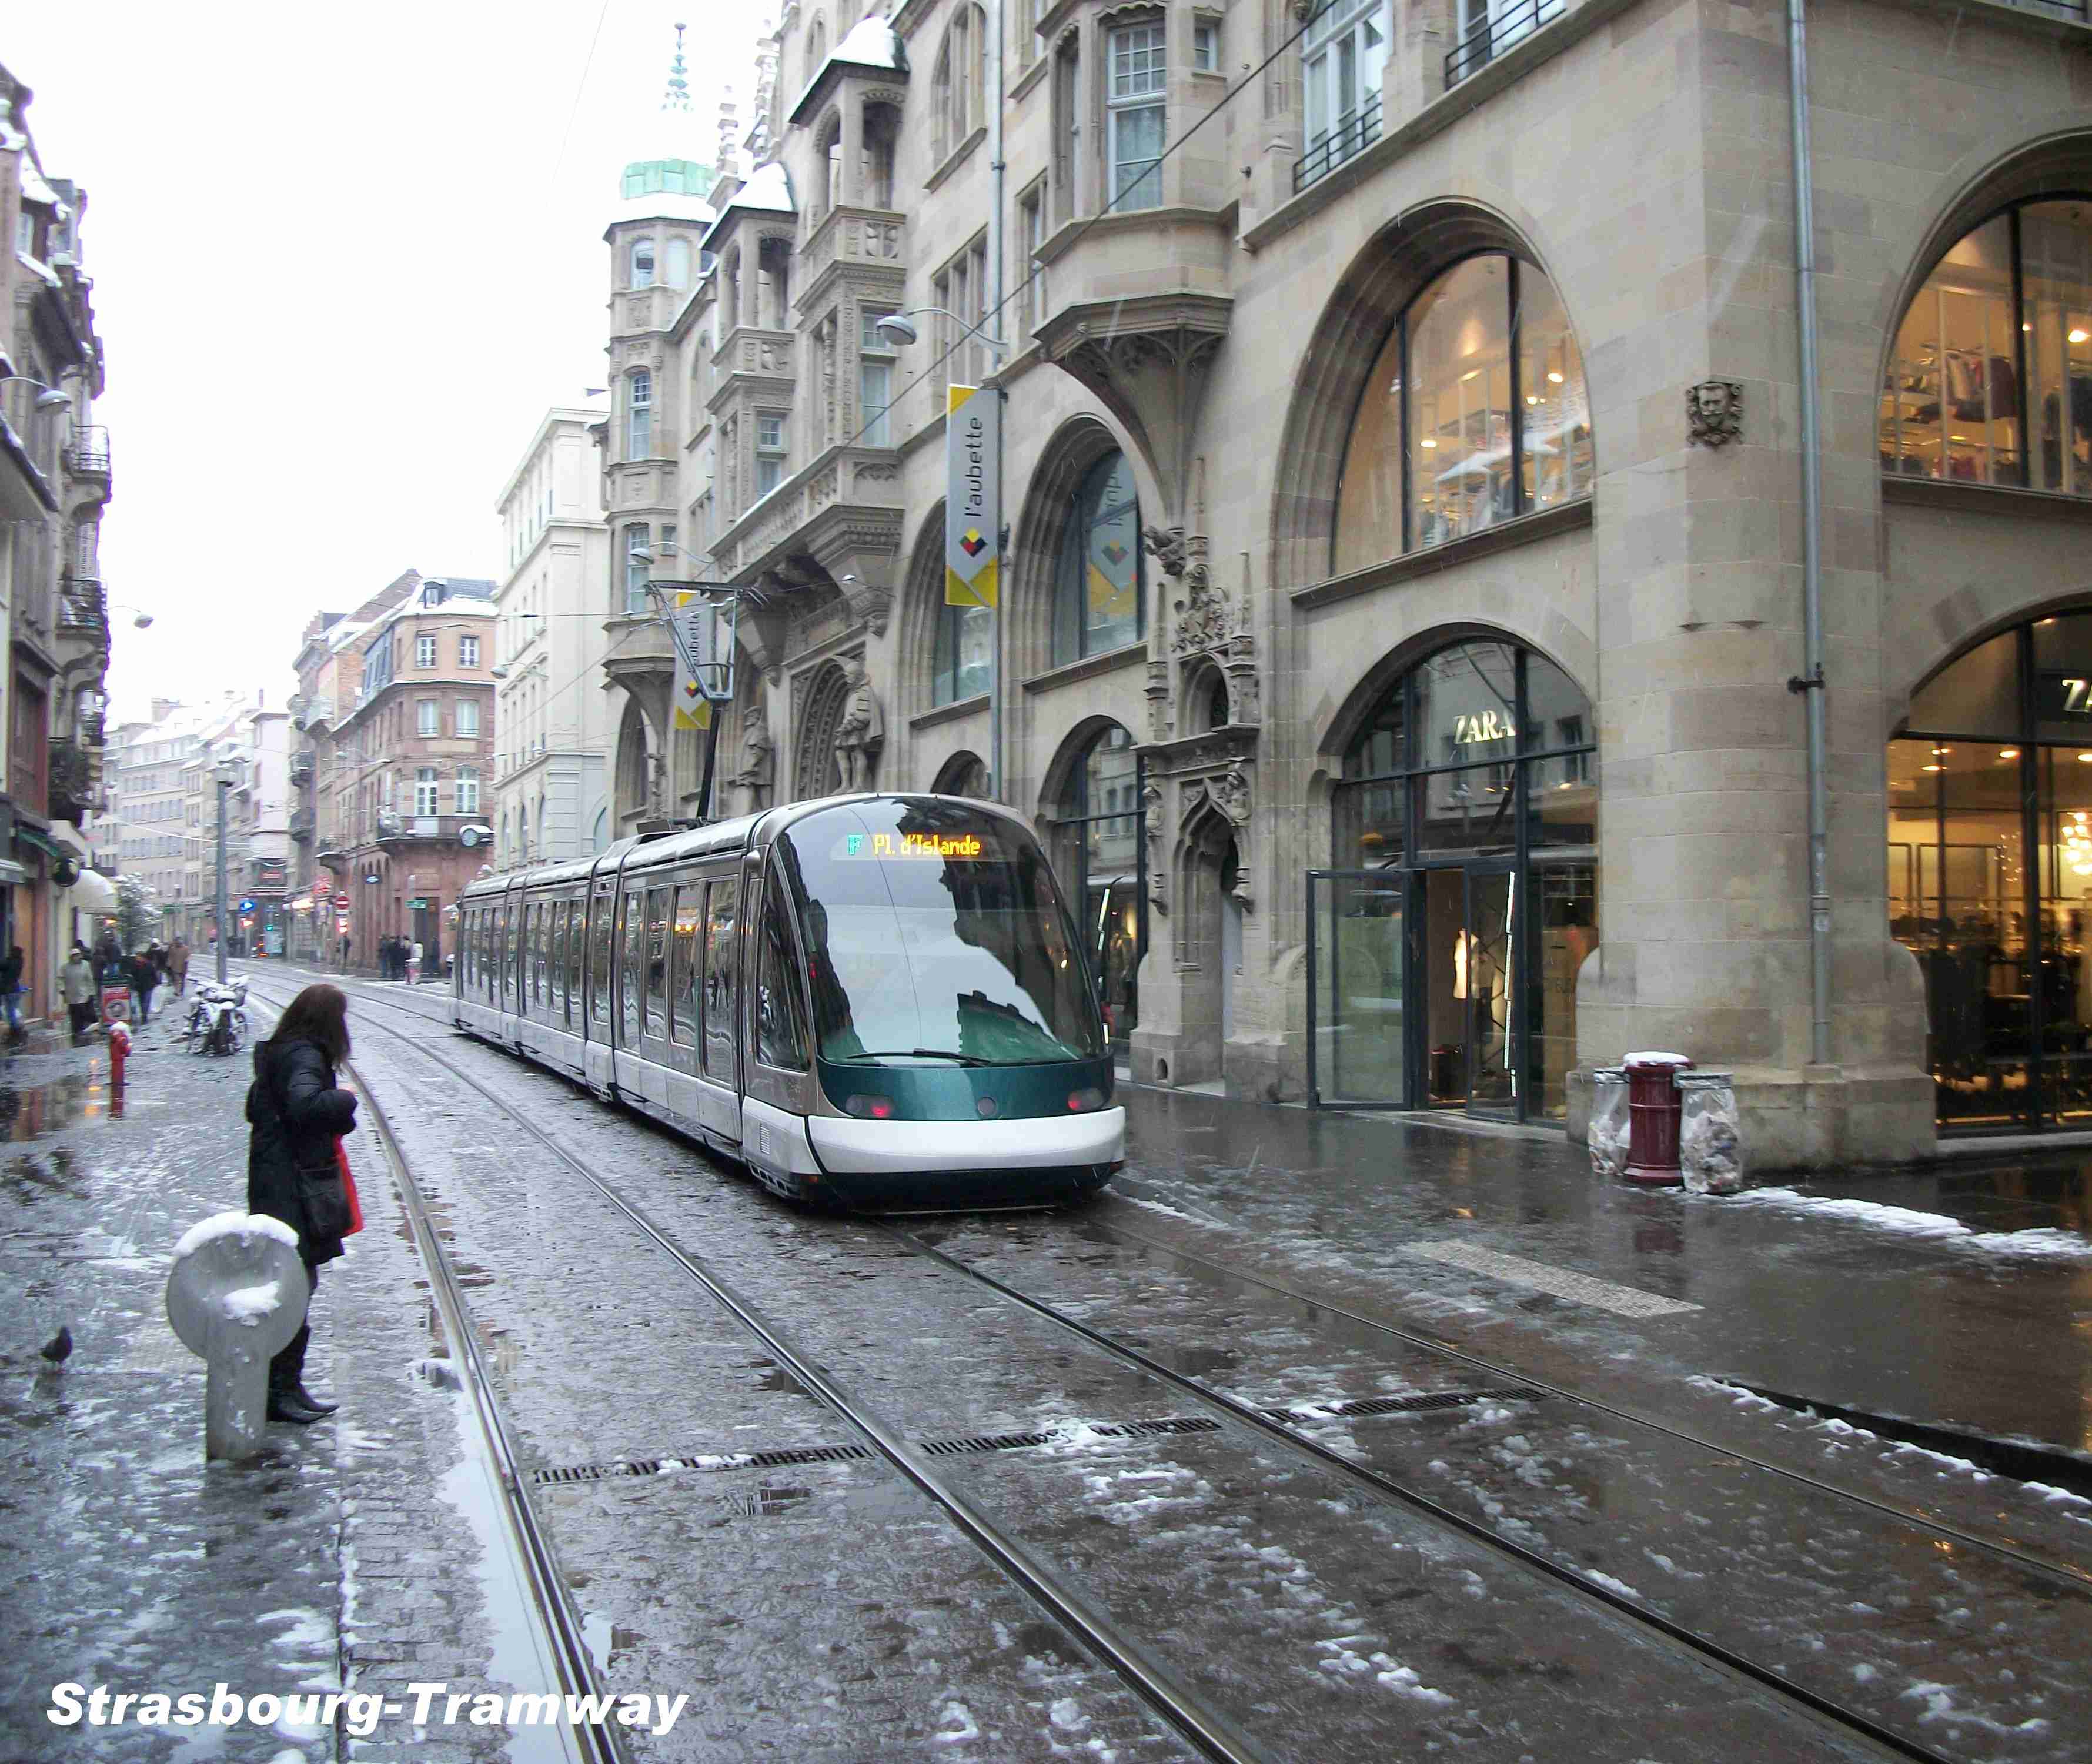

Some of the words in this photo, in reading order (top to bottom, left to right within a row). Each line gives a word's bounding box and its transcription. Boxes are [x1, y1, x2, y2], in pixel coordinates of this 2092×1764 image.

[964, 417, 983, 517] l'aubette
[1453, 710, 1516, 744] ZARA
[847, 834, 864, 856] F
[874, 833, 896, 856] Pl.
[900, 833, 981, 856] d'Islande
